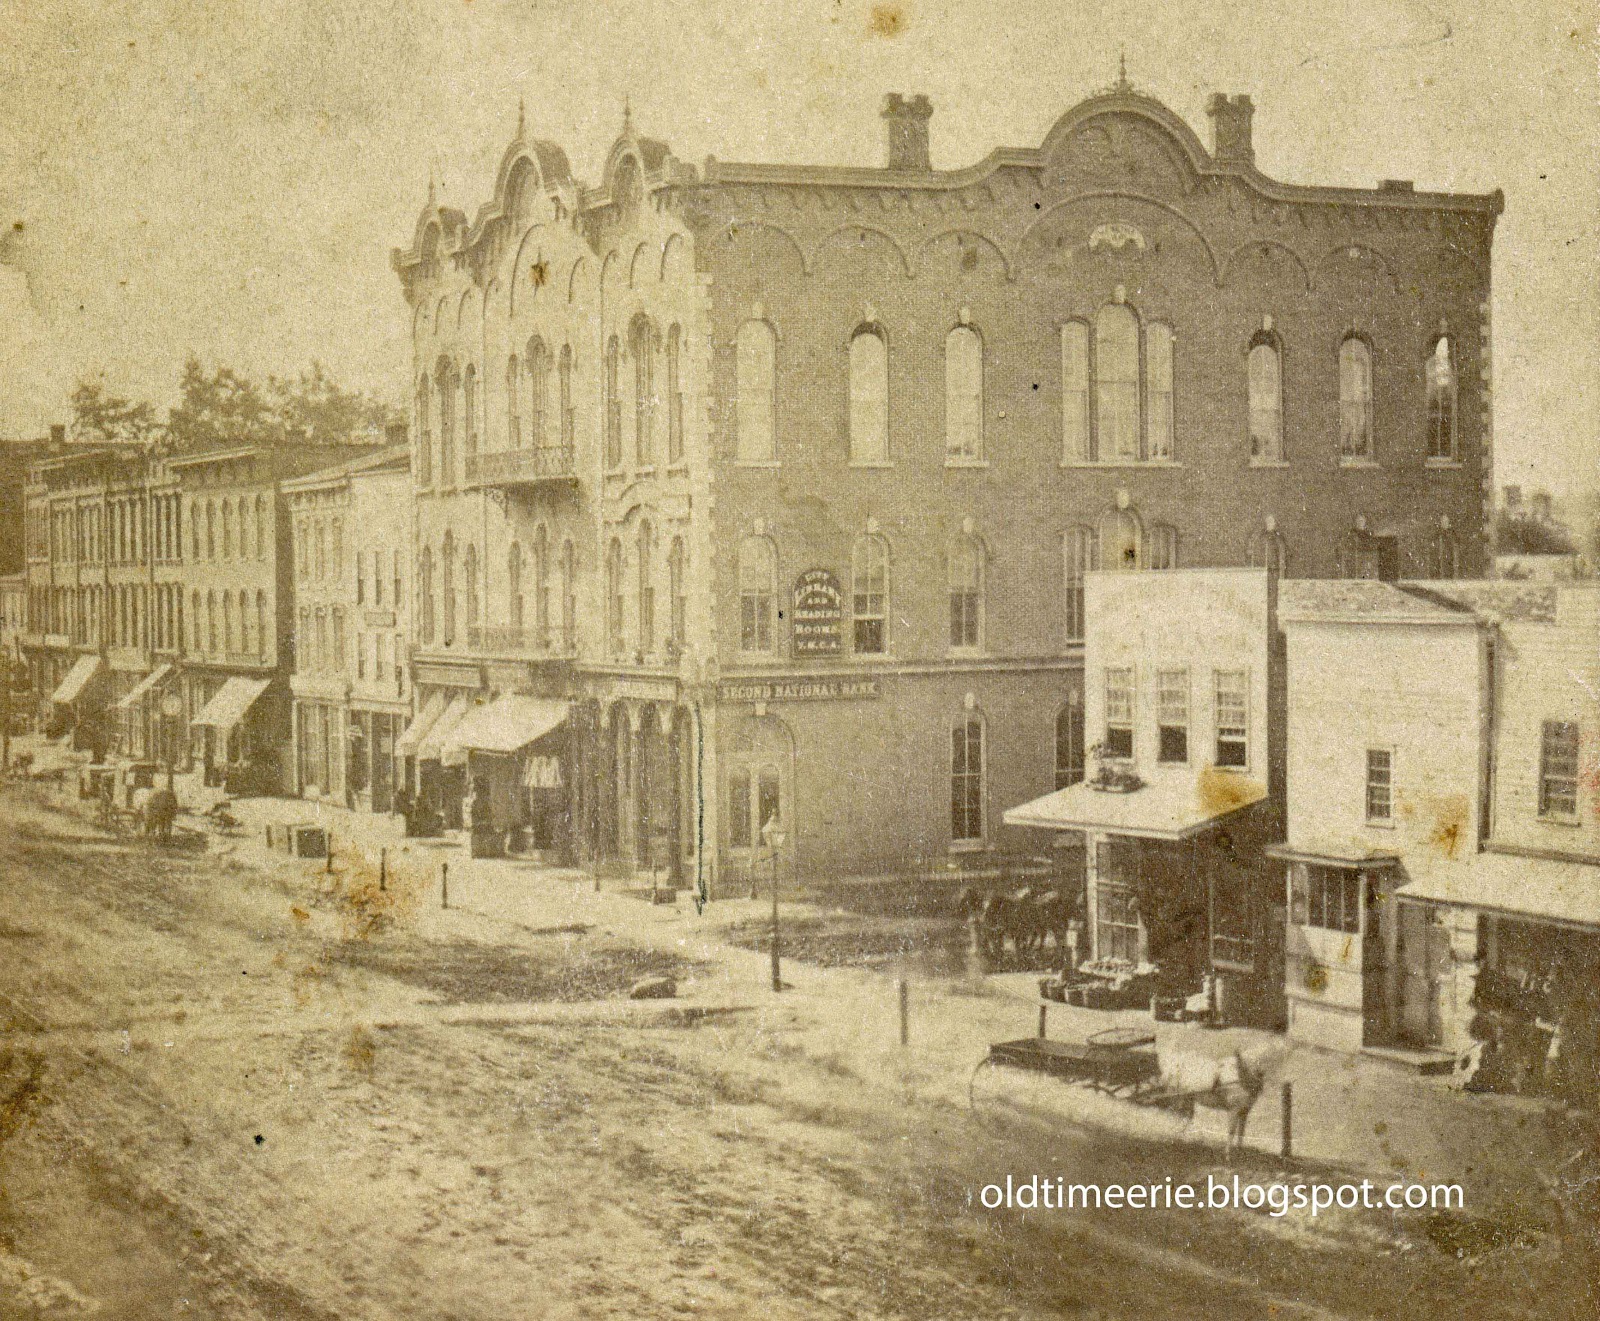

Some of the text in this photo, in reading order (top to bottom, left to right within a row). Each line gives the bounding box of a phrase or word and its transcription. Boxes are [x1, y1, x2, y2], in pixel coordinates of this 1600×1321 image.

[794, 583, 842, 608] LIBRARY
[807, 597, 828, 605] AND
[794, 610, 841, 618] READING
[722, 681, 876, 699] SECOND NATIONAL BANK
